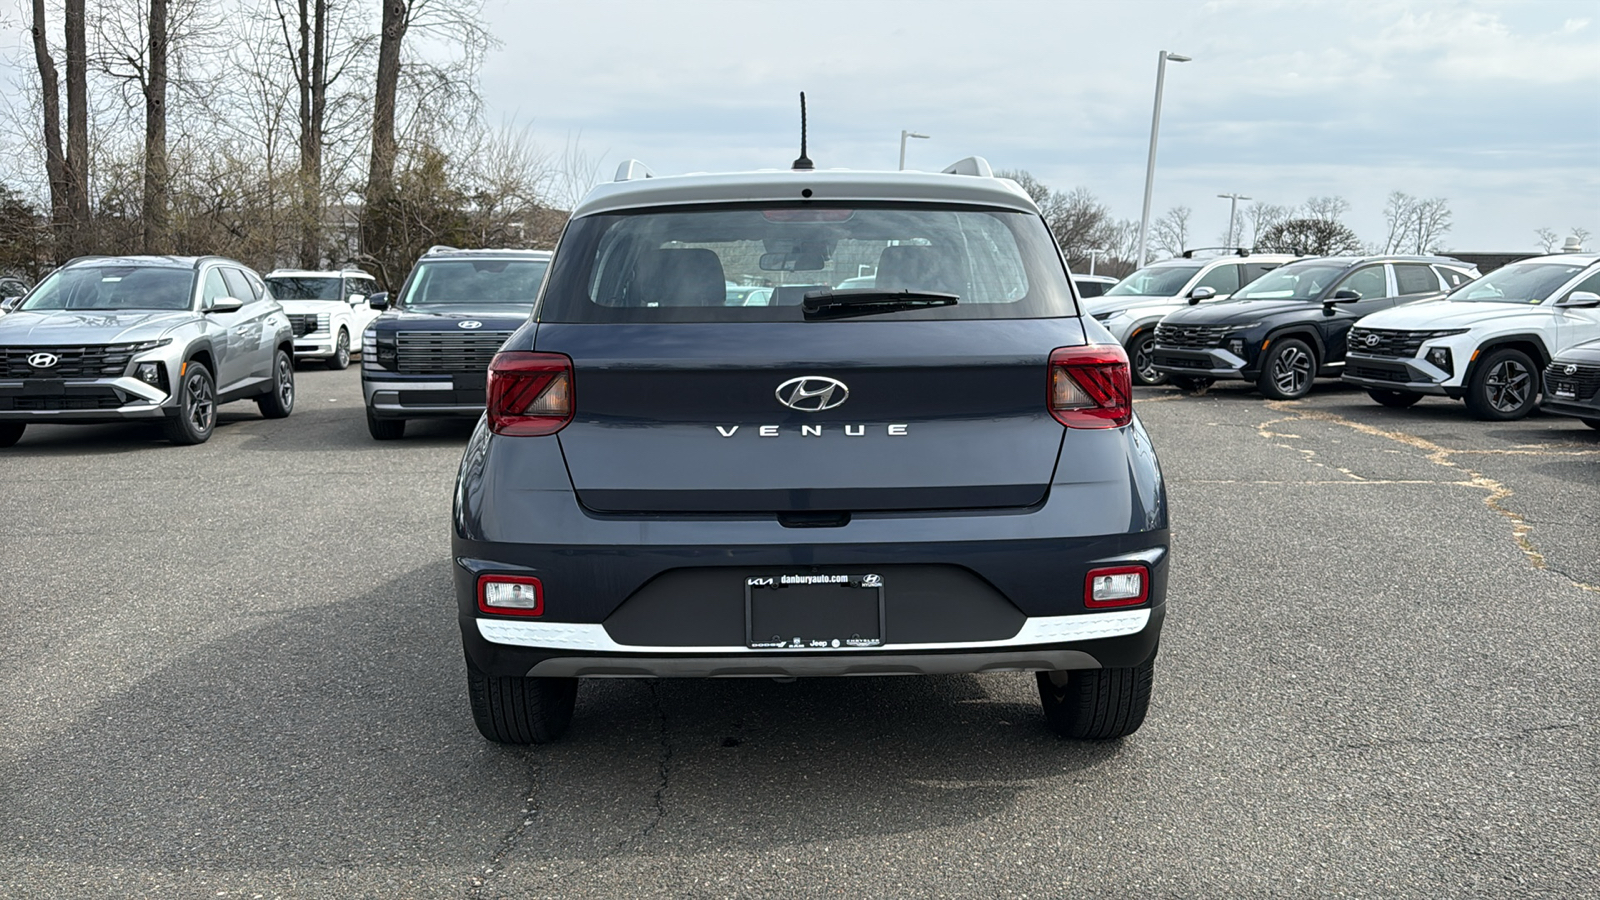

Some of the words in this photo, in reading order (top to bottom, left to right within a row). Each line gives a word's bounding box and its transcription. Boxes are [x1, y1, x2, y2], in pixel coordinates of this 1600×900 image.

[716, 424, 908, 437] VENUE
[748, 578, 773, 586] KIA
[781, 574, 848, 584] danburyauto.com
[809, 640, 828, 648] Jeep
